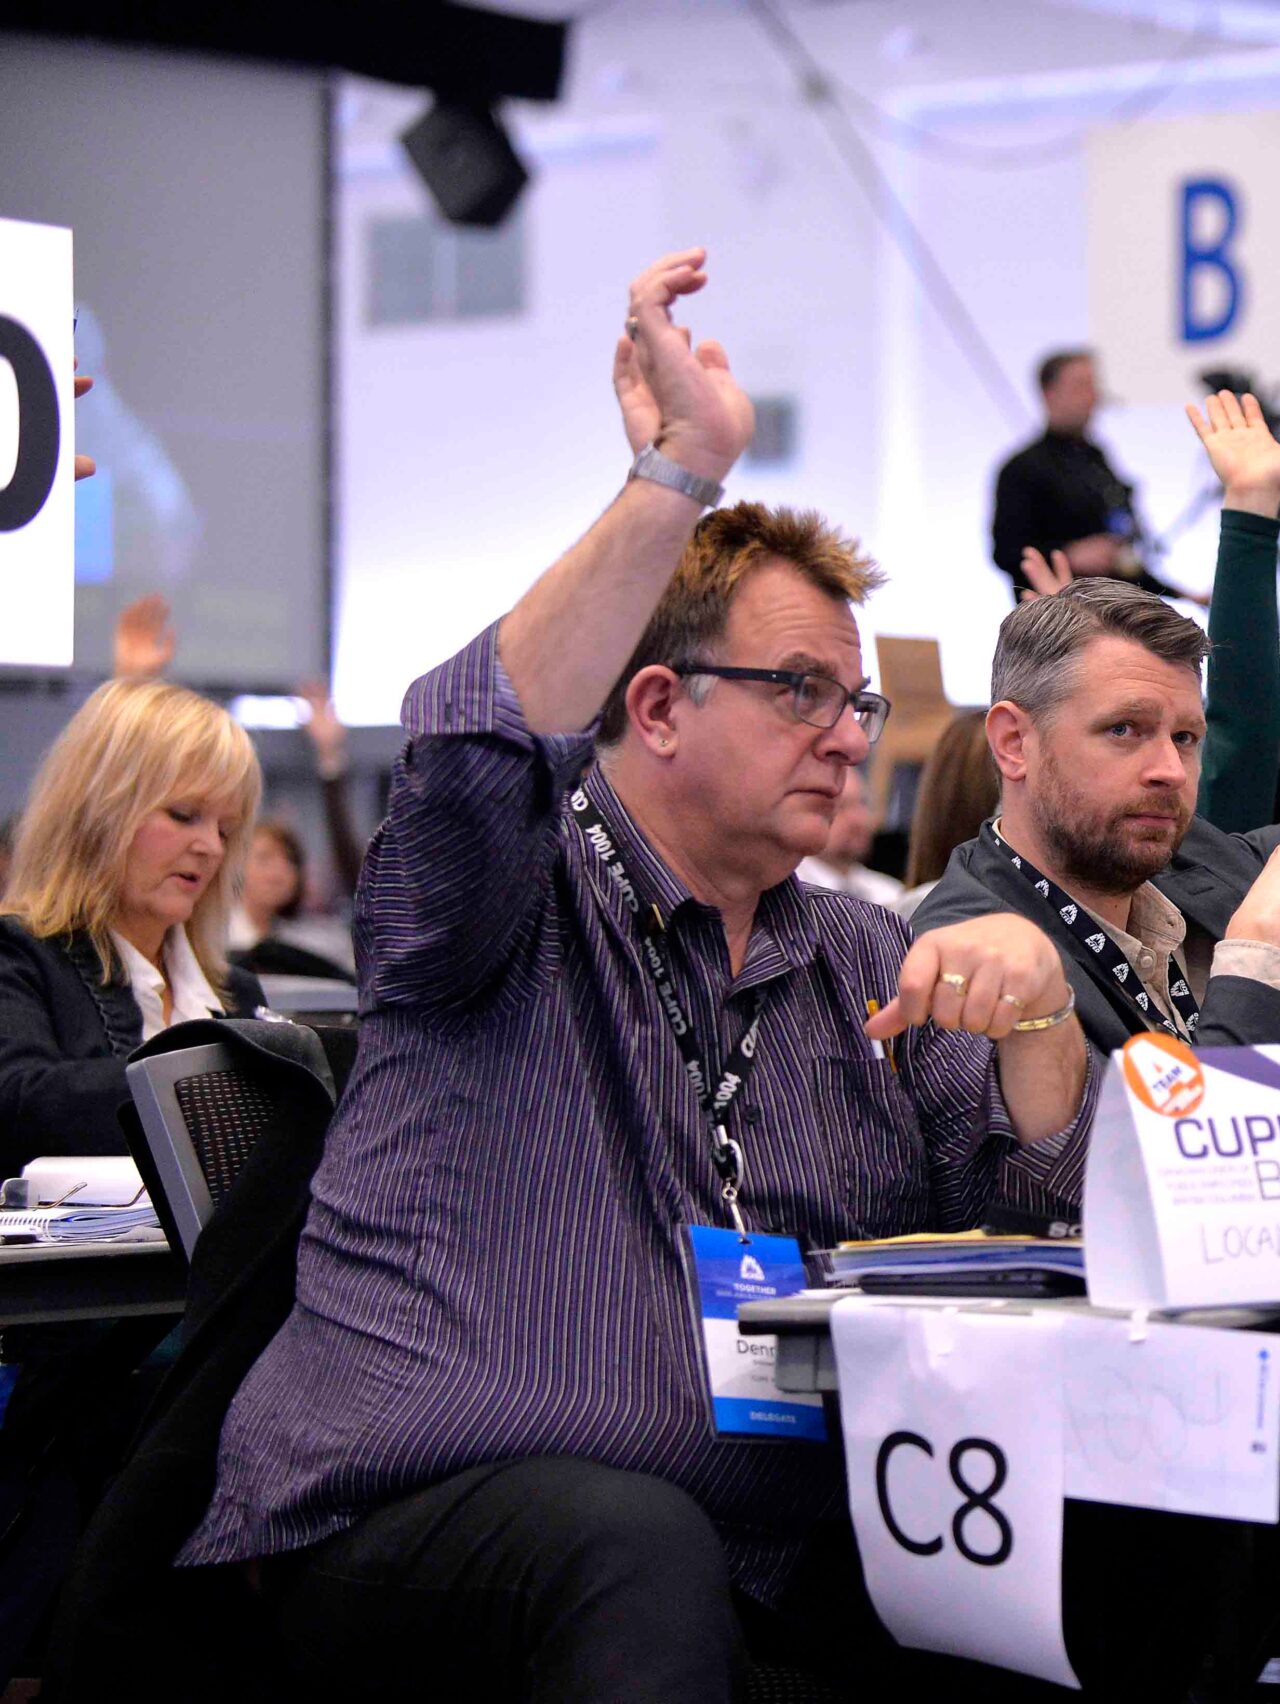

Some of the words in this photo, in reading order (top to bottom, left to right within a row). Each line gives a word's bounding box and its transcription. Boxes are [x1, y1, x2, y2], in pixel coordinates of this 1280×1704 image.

[1176, 176, 1246, 347] B
[585, 824, 616, 861] 1004
[611, 862, 639, 913] CUPE
[659, 981, 687, 1036] CUPE
[713, 1072, 741, 1110] 1004
[733, 1282, 777, 1296] TOGETHER
[875, 1430, 1013, 1567] C8
